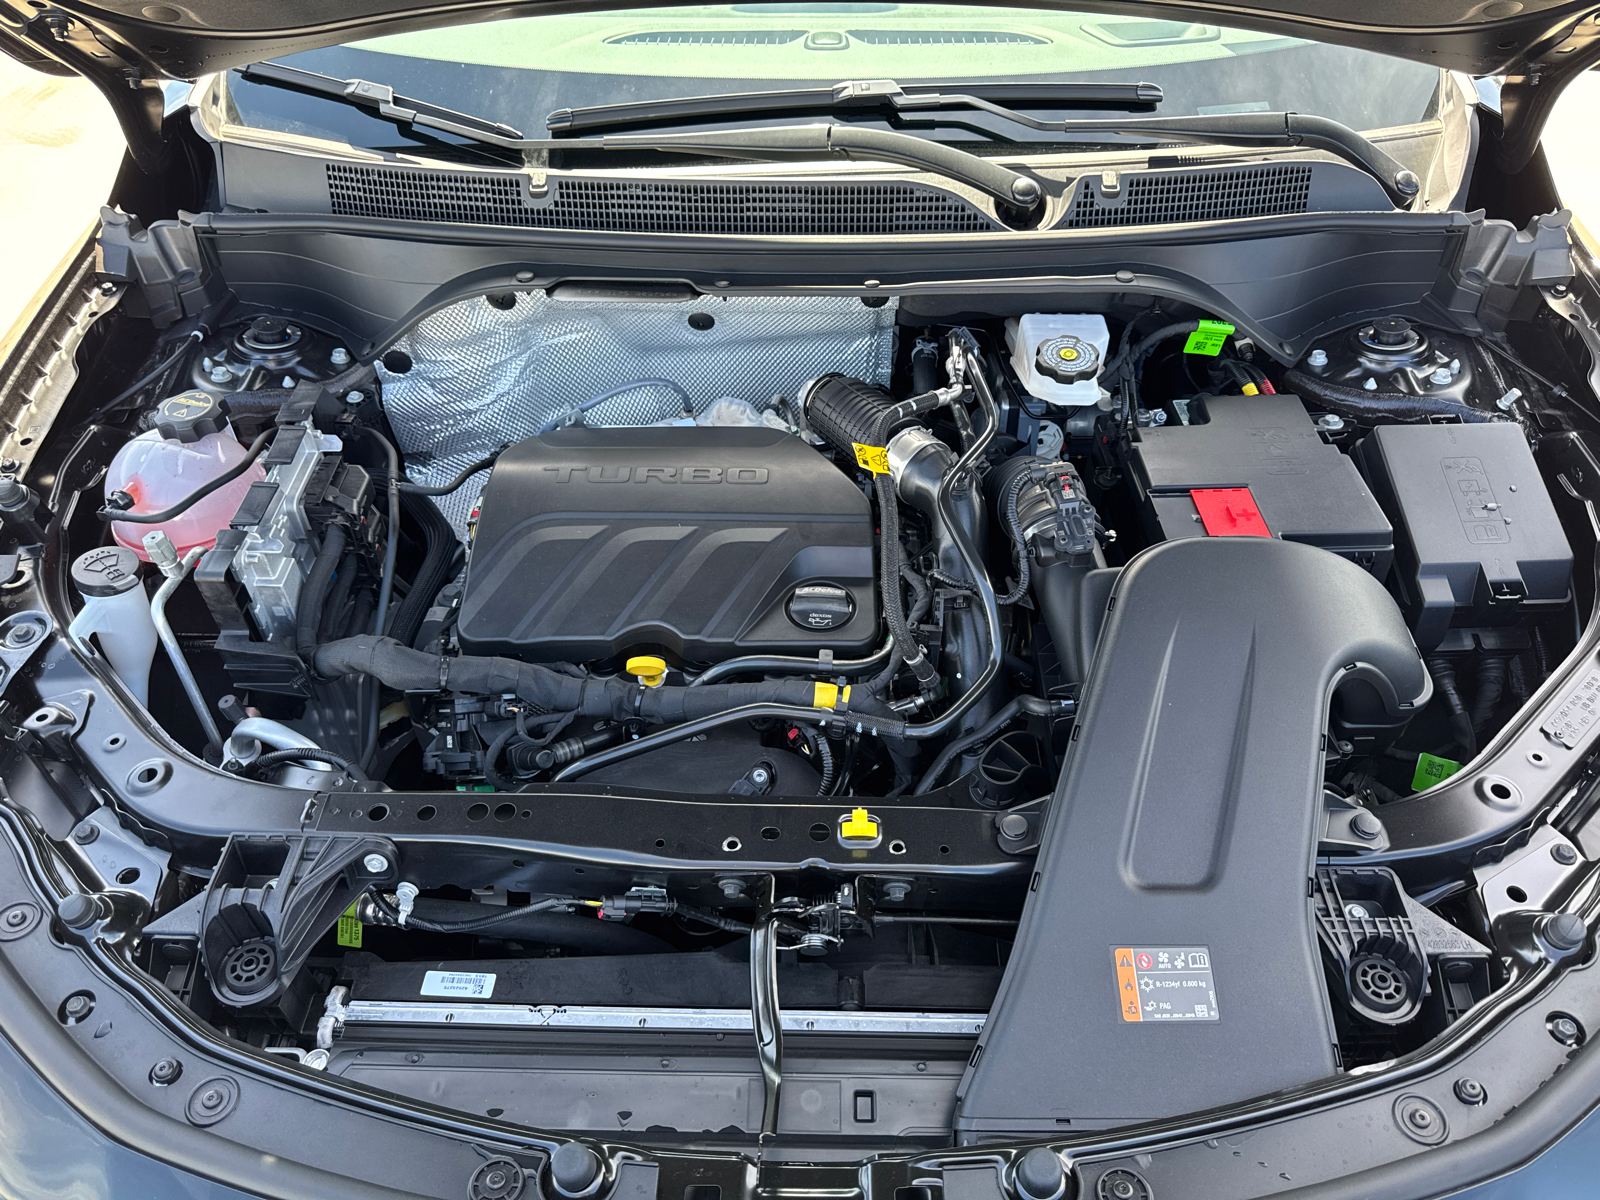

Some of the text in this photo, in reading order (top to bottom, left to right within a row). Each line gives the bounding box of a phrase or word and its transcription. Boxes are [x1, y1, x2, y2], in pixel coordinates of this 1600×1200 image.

[543, 466, 770, 485] TURBO
[1155, 981, 1180, 989] R-1234yf
[1198, 980, 1207, 988] kg
[1159, 1002, 1172, 1010] PAG
